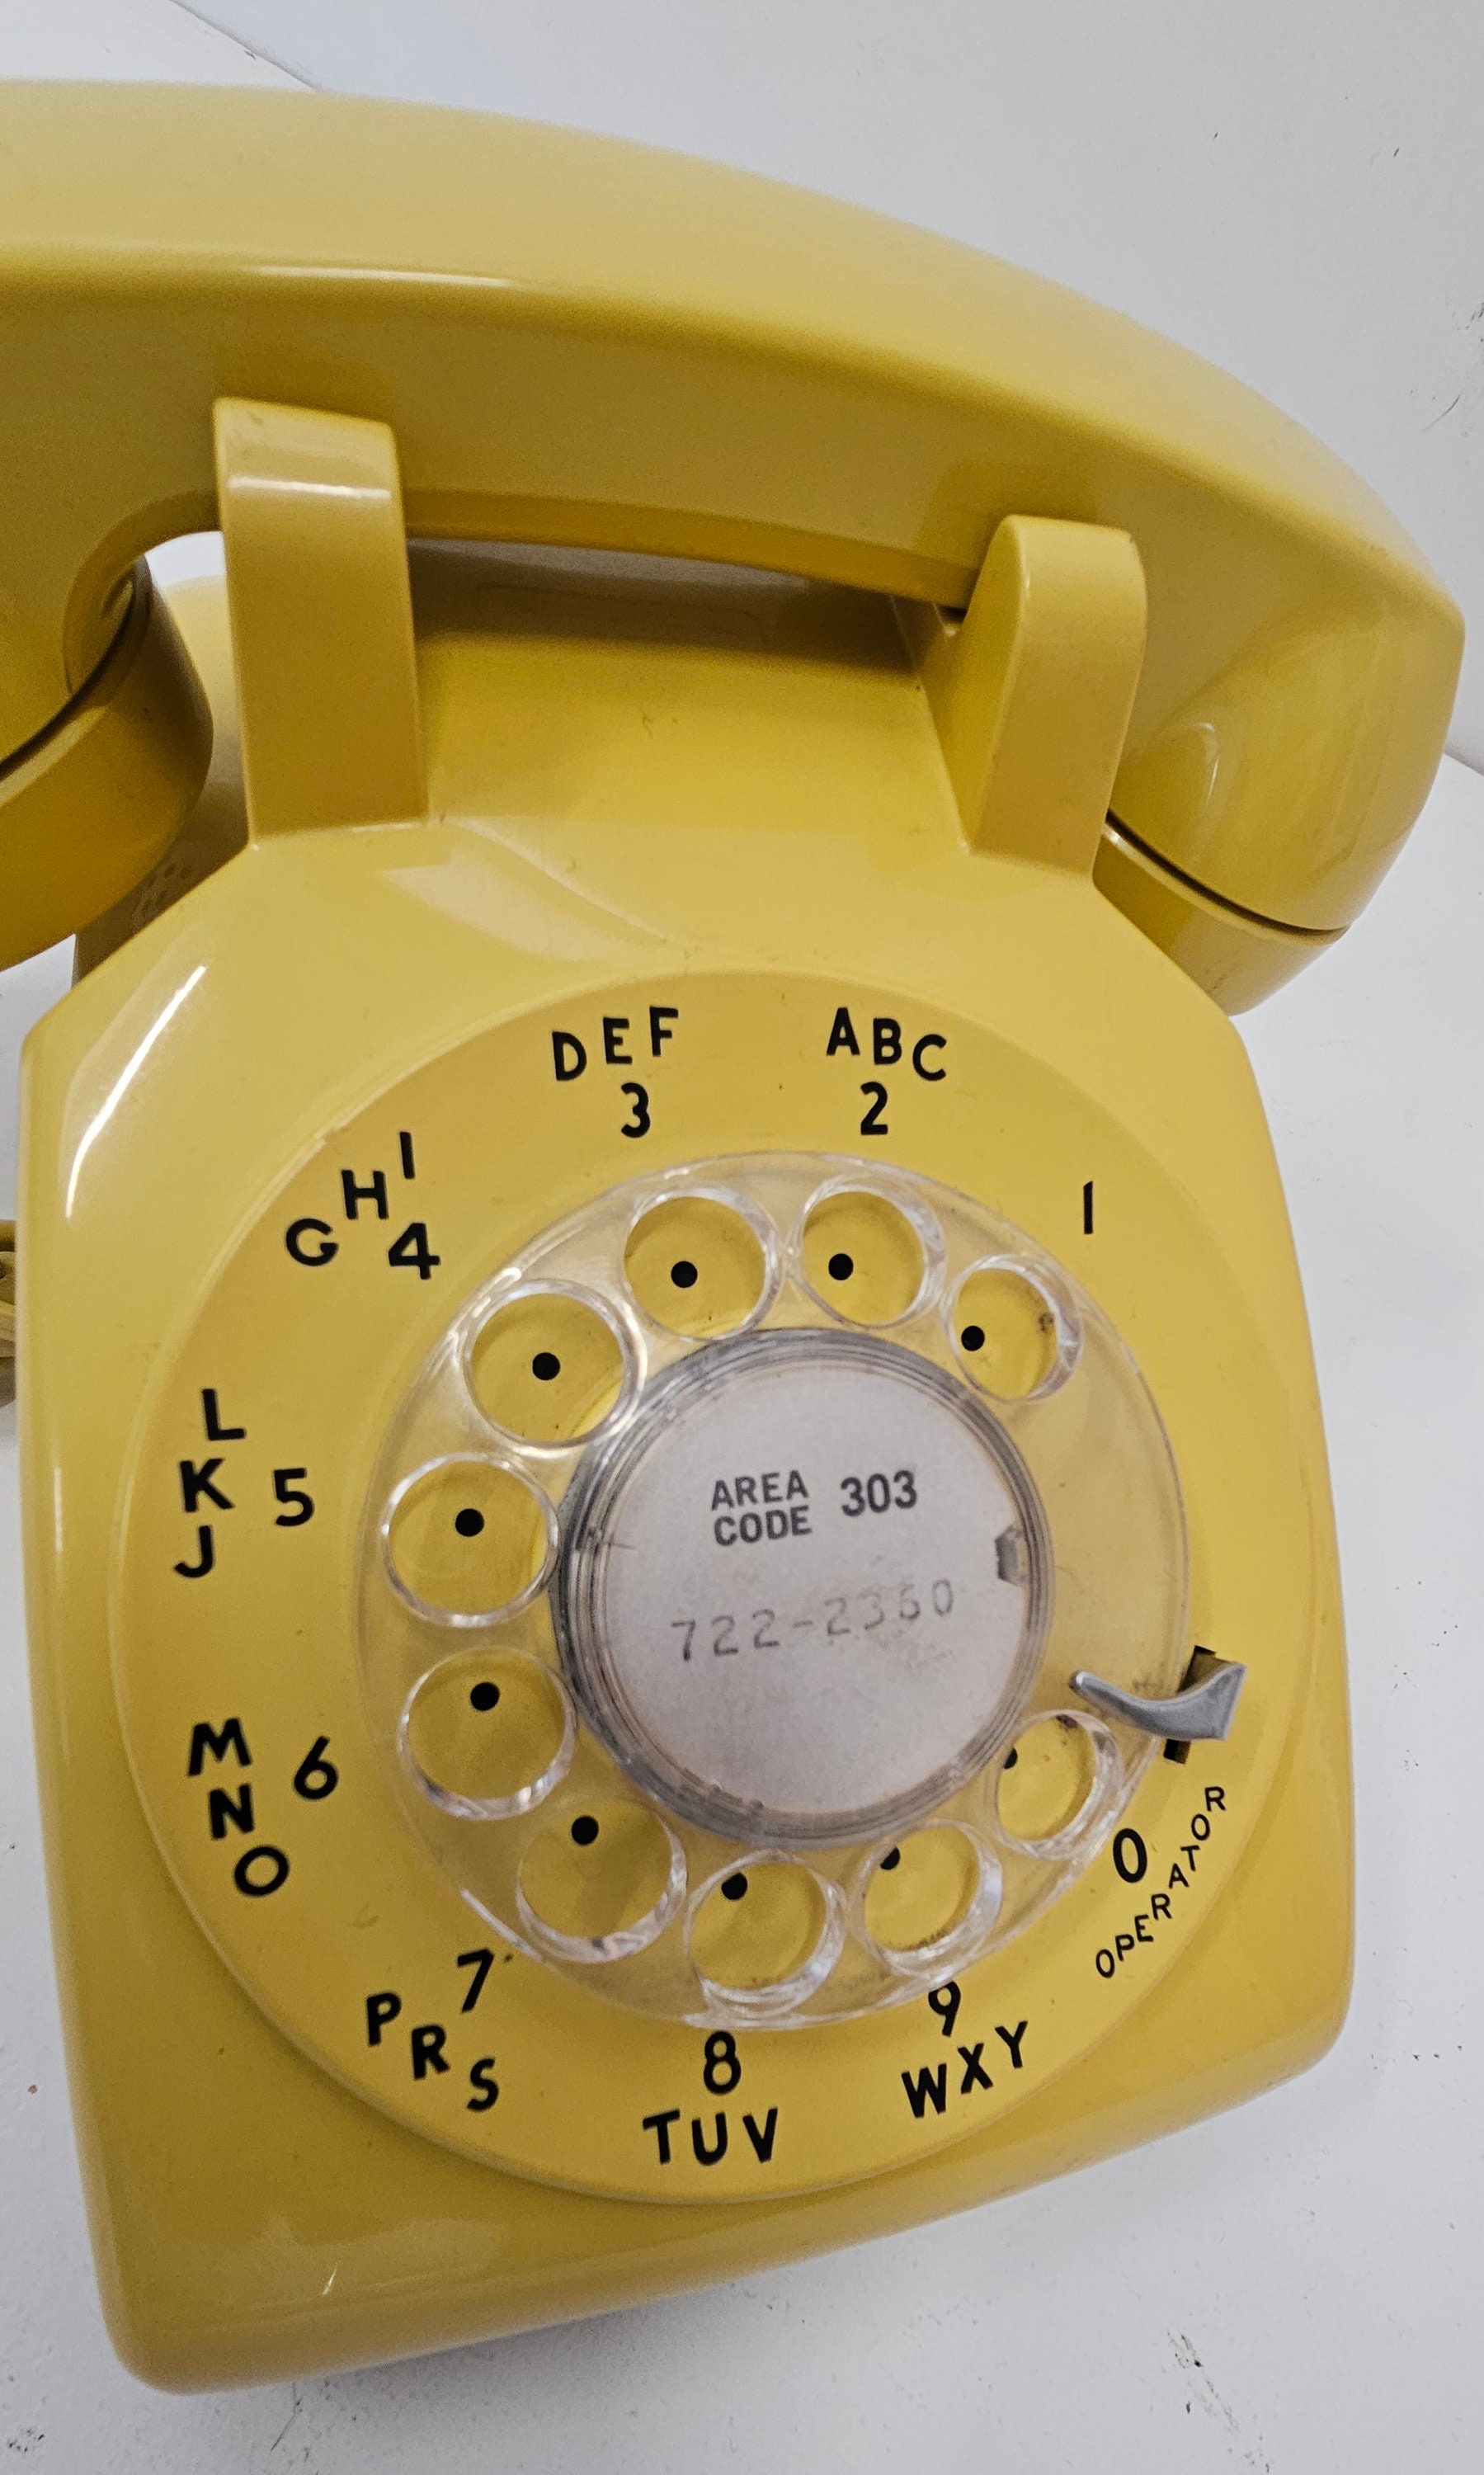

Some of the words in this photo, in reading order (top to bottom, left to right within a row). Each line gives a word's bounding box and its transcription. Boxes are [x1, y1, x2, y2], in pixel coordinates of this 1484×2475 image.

[552, 1006, 678, 1081] DEF
[827, 1007, 946, 1081] ABC
[621, 1082, 650, 1138] 3
[861, 1082, 889, 1135] 2
[1082, 1180, 1094, 1236] 1
[389, 1223, 440, 1280] 4
[274, 1468, 313, 1526] 5
[711, 1470, 808, 1511] AREA
[840, 1469, 917, 1516] 303
[714, 1506, 812, 1546] CODE
[294, 1736, 338, 1800] 6
[1096, 1787, 1225, 1978] OPERATOR
[457, 1948, 494, 2013] 7
[928, 1982, 960, 2036] 9
[366, 1992, 498, 2112] PRS
[704, 2031, 741, 2095] 8
[902, 2021, 1027, 2118] WXY
[643, 2108, 777, 2166] TUV
